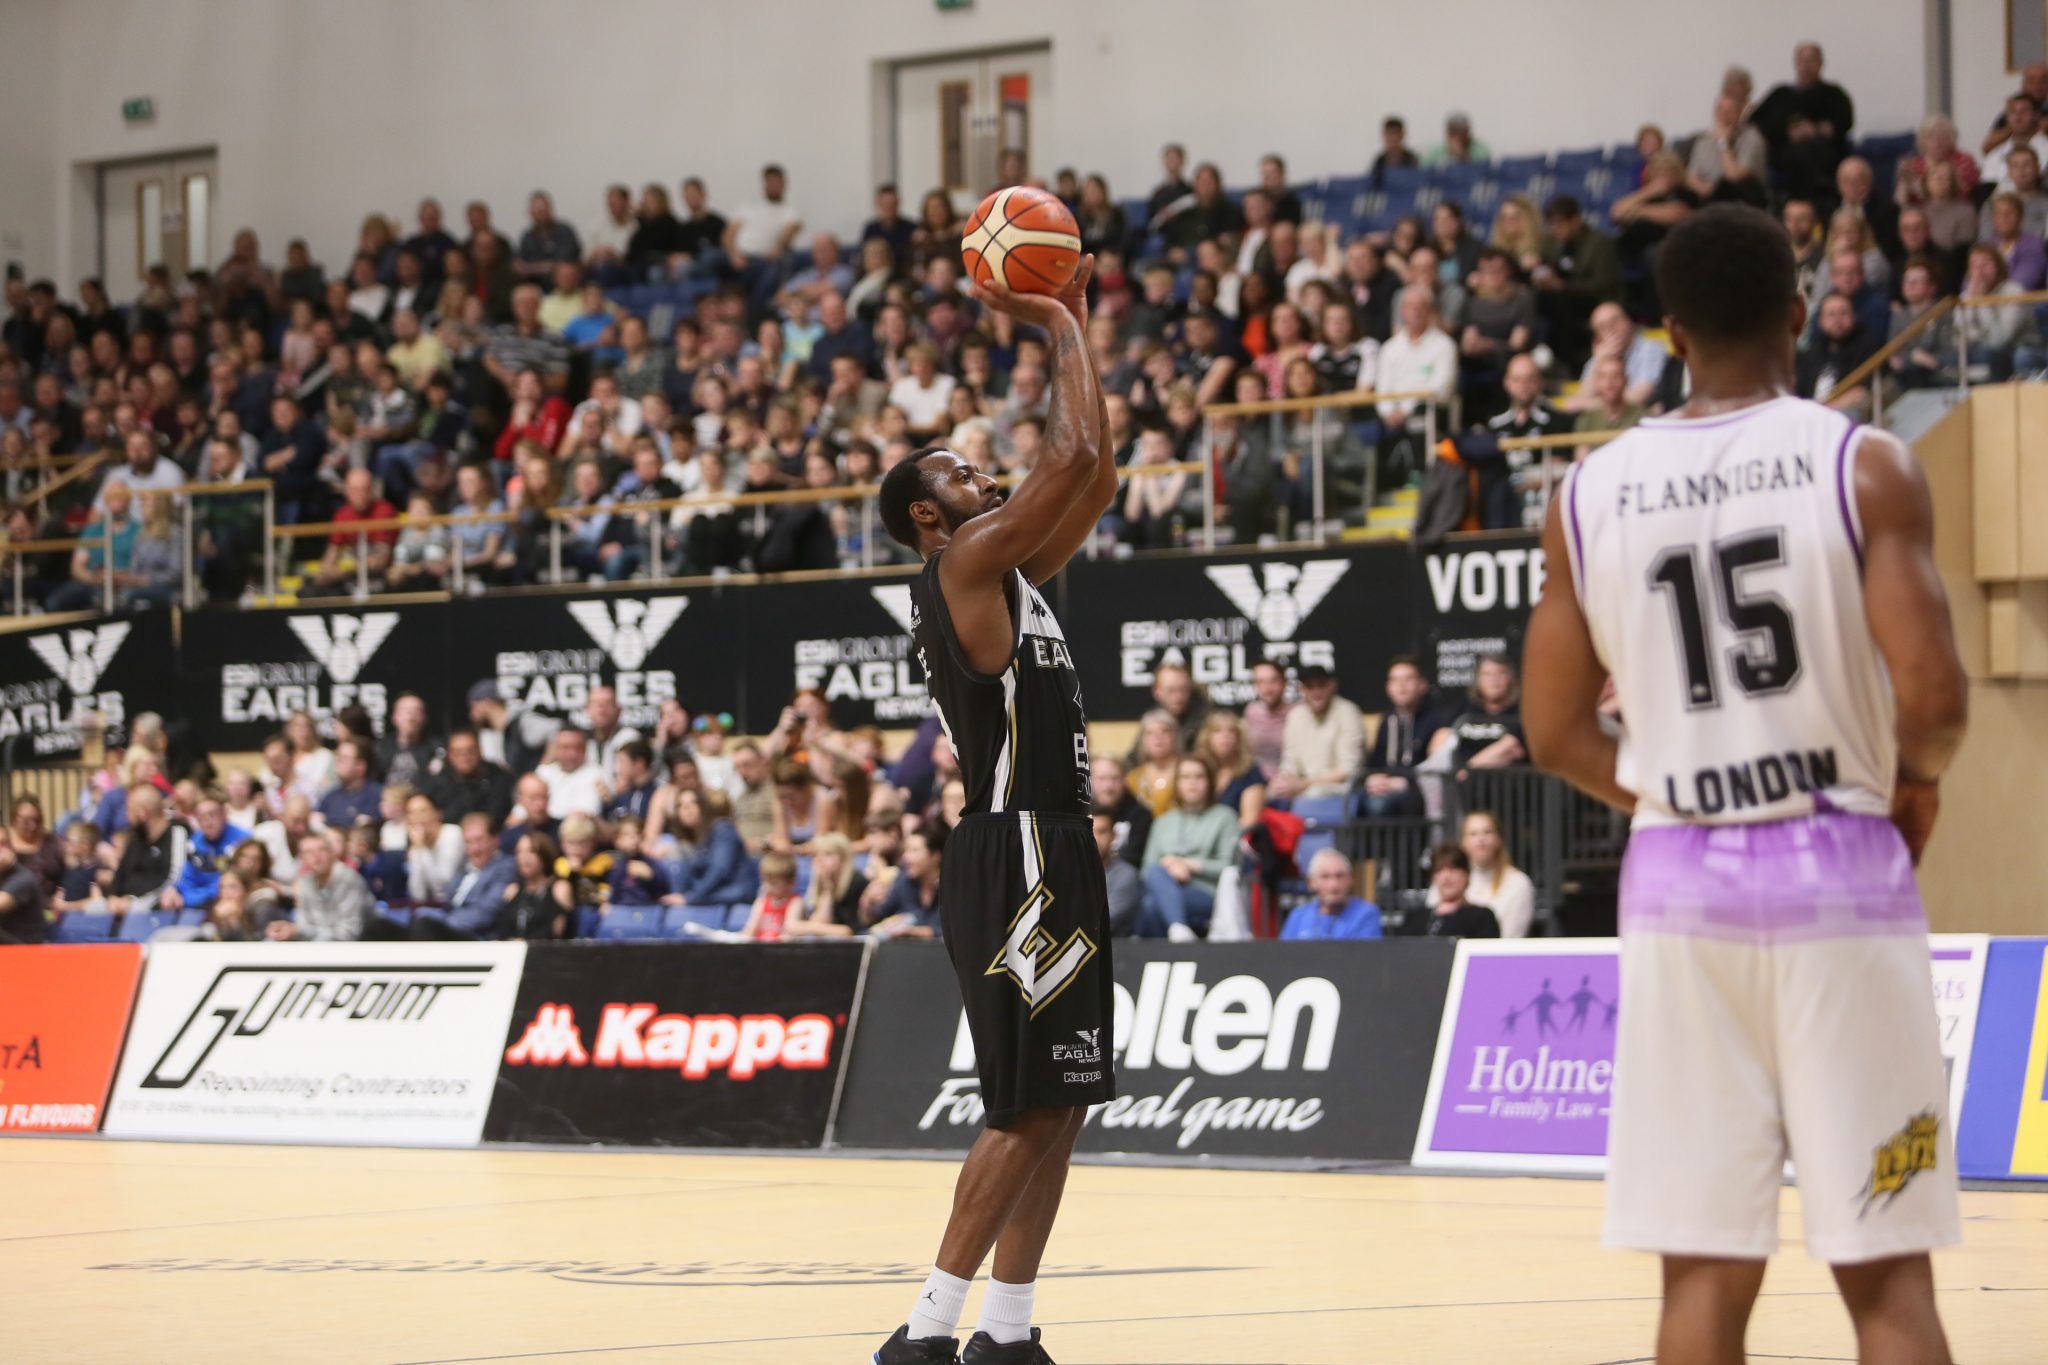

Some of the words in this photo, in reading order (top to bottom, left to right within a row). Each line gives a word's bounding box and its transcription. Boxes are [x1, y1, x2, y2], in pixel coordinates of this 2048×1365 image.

[1618, 453, 1815, 516] FLANNIGAN
[1647, 525, 1802, 712] 15
[795, 660, 928, 700] EAGL
[0, 690, 125, 742] AGLES
[1666, 747, 1838, 816] LONDON
[593, 1002, 834, 1080] Kappa
[332, 1073, 471, 1096] Contractors
[1467, 1044, 1616, 1094] Holme
[1176, 1096, 1326, 1148] game
[1555, 1098, 1597, 1119] Law
